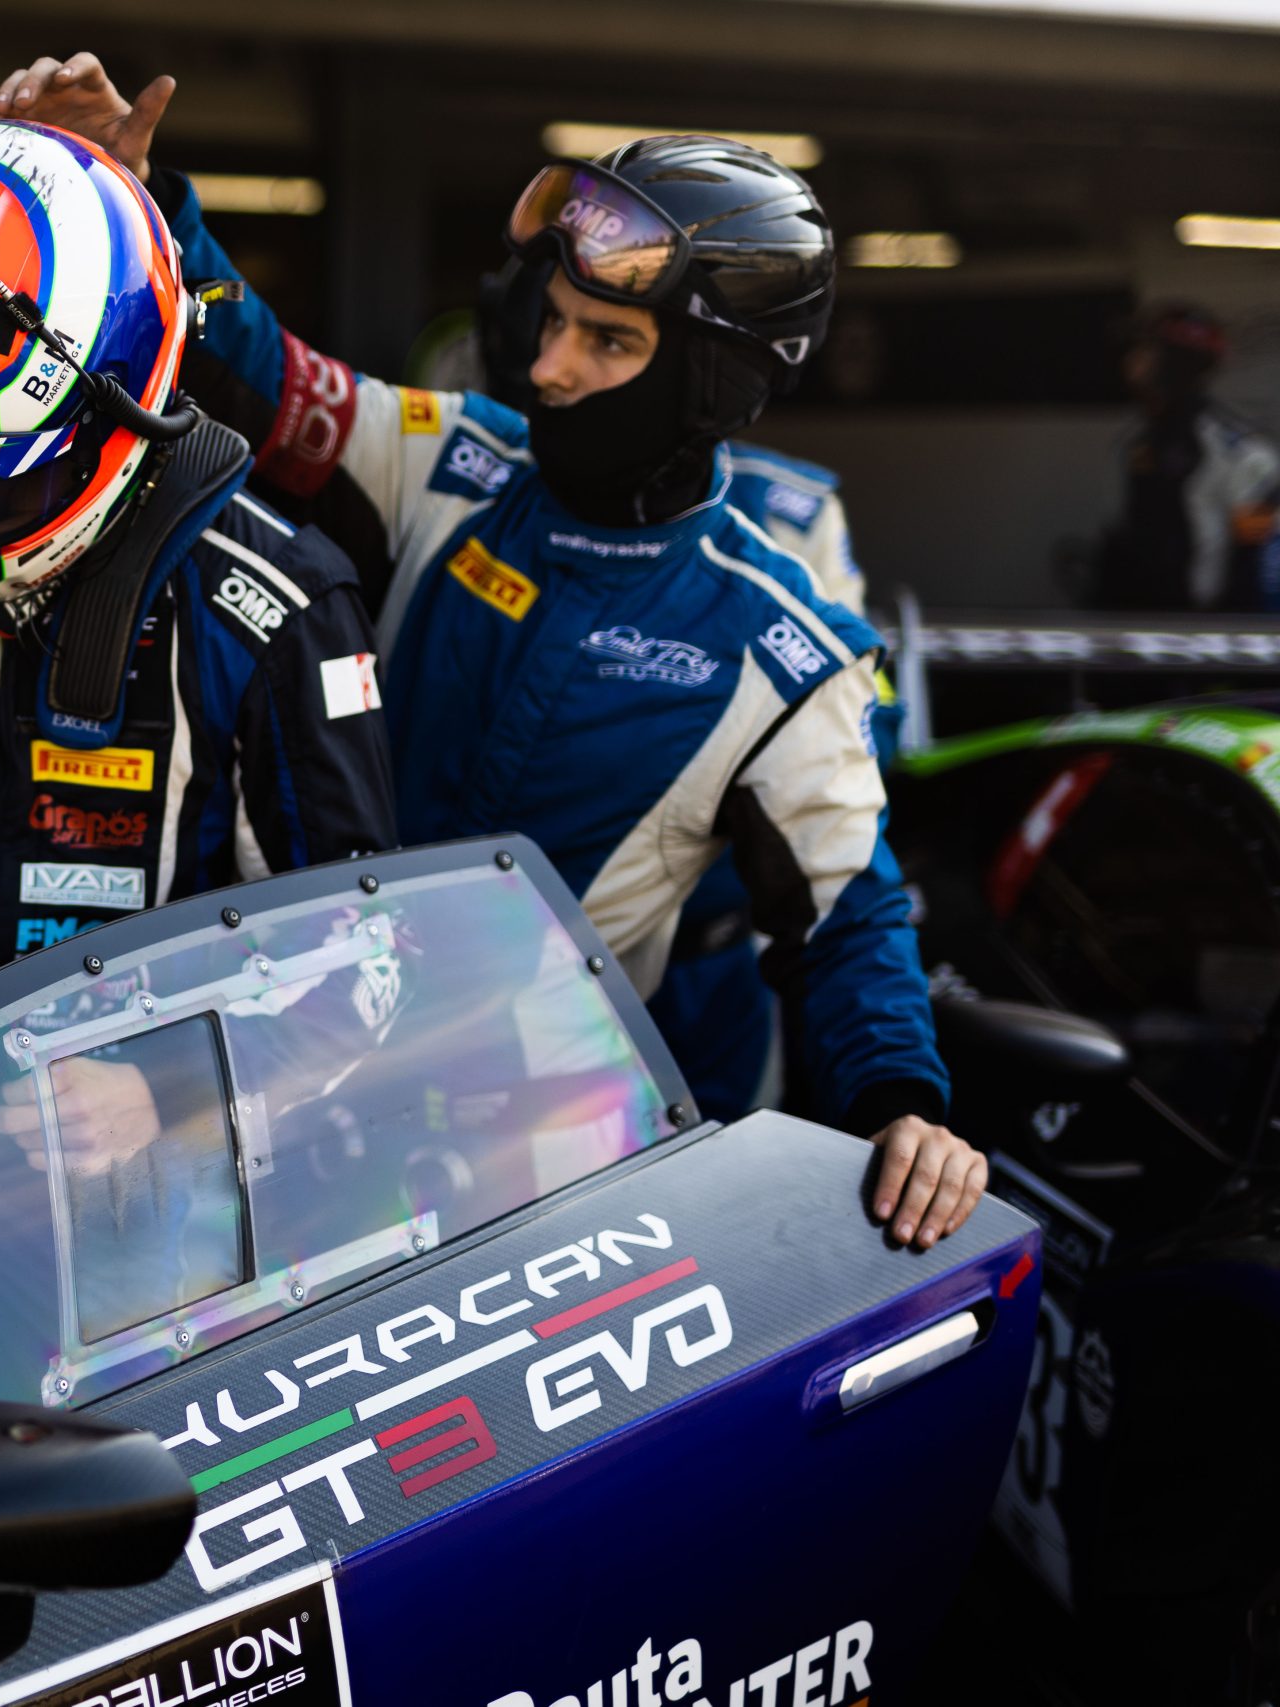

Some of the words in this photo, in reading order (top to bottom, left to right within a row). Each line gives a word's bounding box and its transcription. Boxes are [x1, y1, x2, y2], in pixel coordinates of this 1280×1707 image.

[560, 198, 624, 240] OMP
[43, 350, 79, 407] MARKETIG
[220, 576, 283, 629] OMP
[766, 622, 821, 674] OMP
[38, 750, 142, 782] PIRELLI
[26, 867, 142, 894] IVAM
[185, 1396, 498, 1593] GT3
[526, 1283, 733, 1432] EVO
